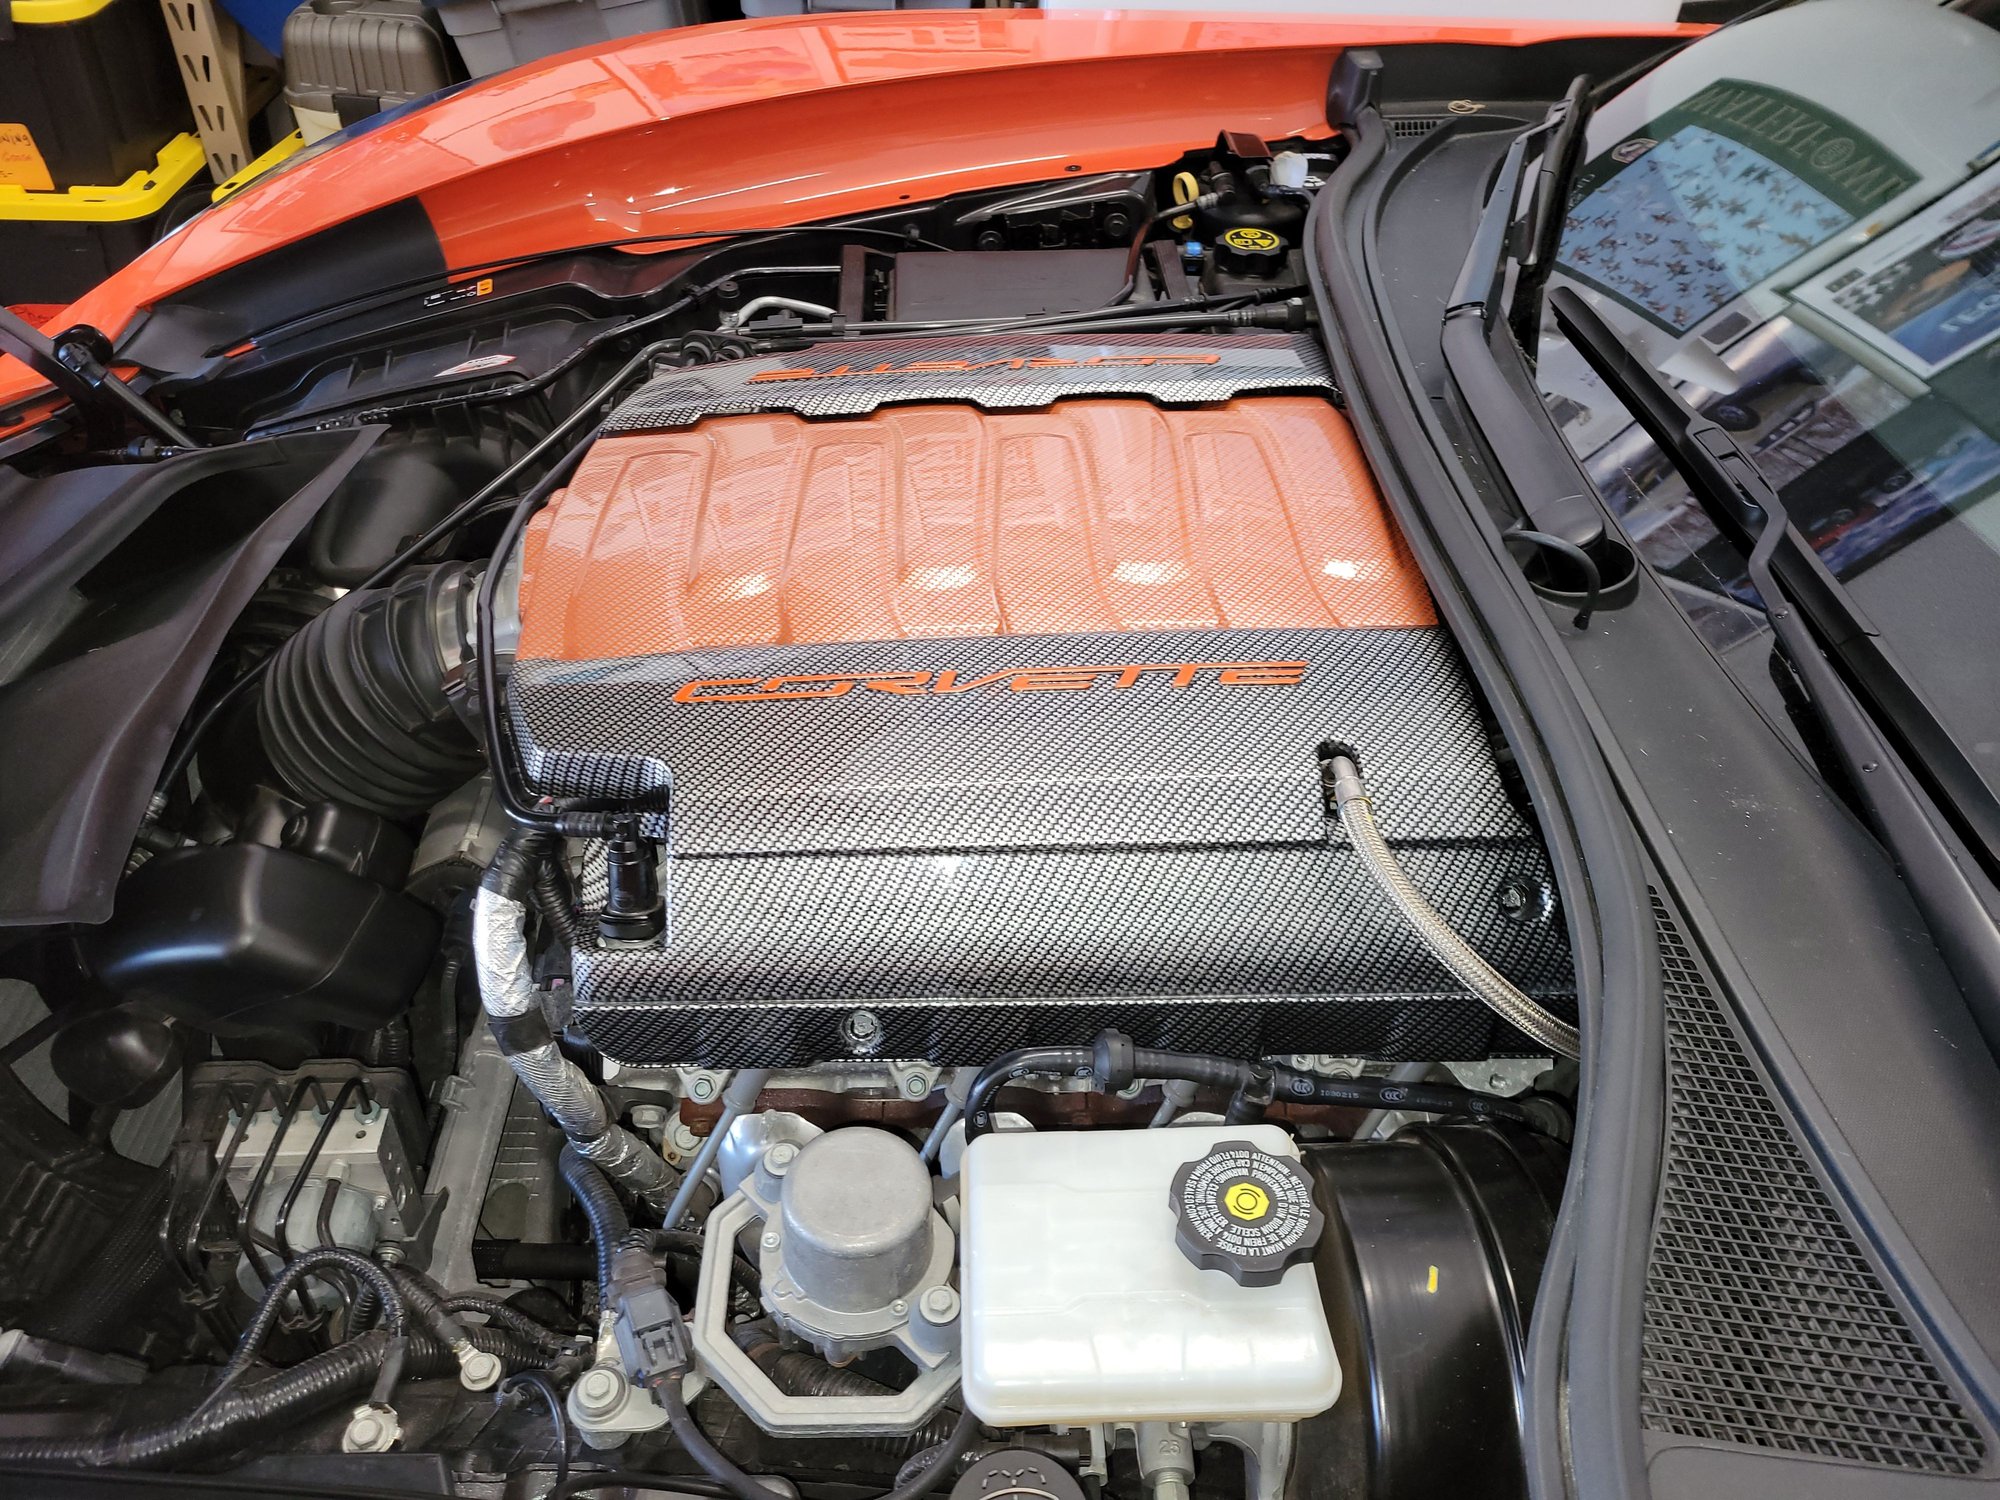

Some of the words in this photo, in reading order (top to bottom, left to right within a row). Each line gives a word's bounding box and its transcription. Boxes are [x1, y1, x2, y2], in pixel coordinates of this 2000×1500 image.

[672, 660, 1308, 703] CORVETTE
[1208, 1151, 1231, 1165] FLUID
[1229, 1150, 1250, 1158] DOT4
[1192, 1159, 1213, 1177] FROM
[1208, 1159, 1236, 1176] BEFORE
[1236, 1159, 1250, 1167] CAP
[1183, 1179, 1198, 1204] SEALED
[1205, 1183, 1220, 1204] CLEAN
[1251, 1169, 1288, 1201] PROVENANT
[1289, 1175, 1311, 1208] NETTOYER
[1286, 1190, 1299, 1204] QUE
[1196, 1205, 1211, 1220] USE
[1206, 1204, 1229, 1228] FILLER
[1288, 1204, 1300, 1215] DU
[1300, 1208, 1311, 1218] LE
[1203, 1218, 1224, 1235] ONLY
[1260, 1217, 1284, 1235] BIDON
[1275, 1214, 1298, 1239] LIQUIDE
[1282, 1218, 1309, 1247] BOUCHON
[1222, 1231, 1243, 1245] DOT4
[1243, 1237, 1268, 1247] FREIN
[1266, 1233, 1280, 1244] DE
[1248, 1247, 1260, 1256] LA
[1261, 1241, 1286, 1256] AVANT
[1159, 1439, 1181, 1456] 25
